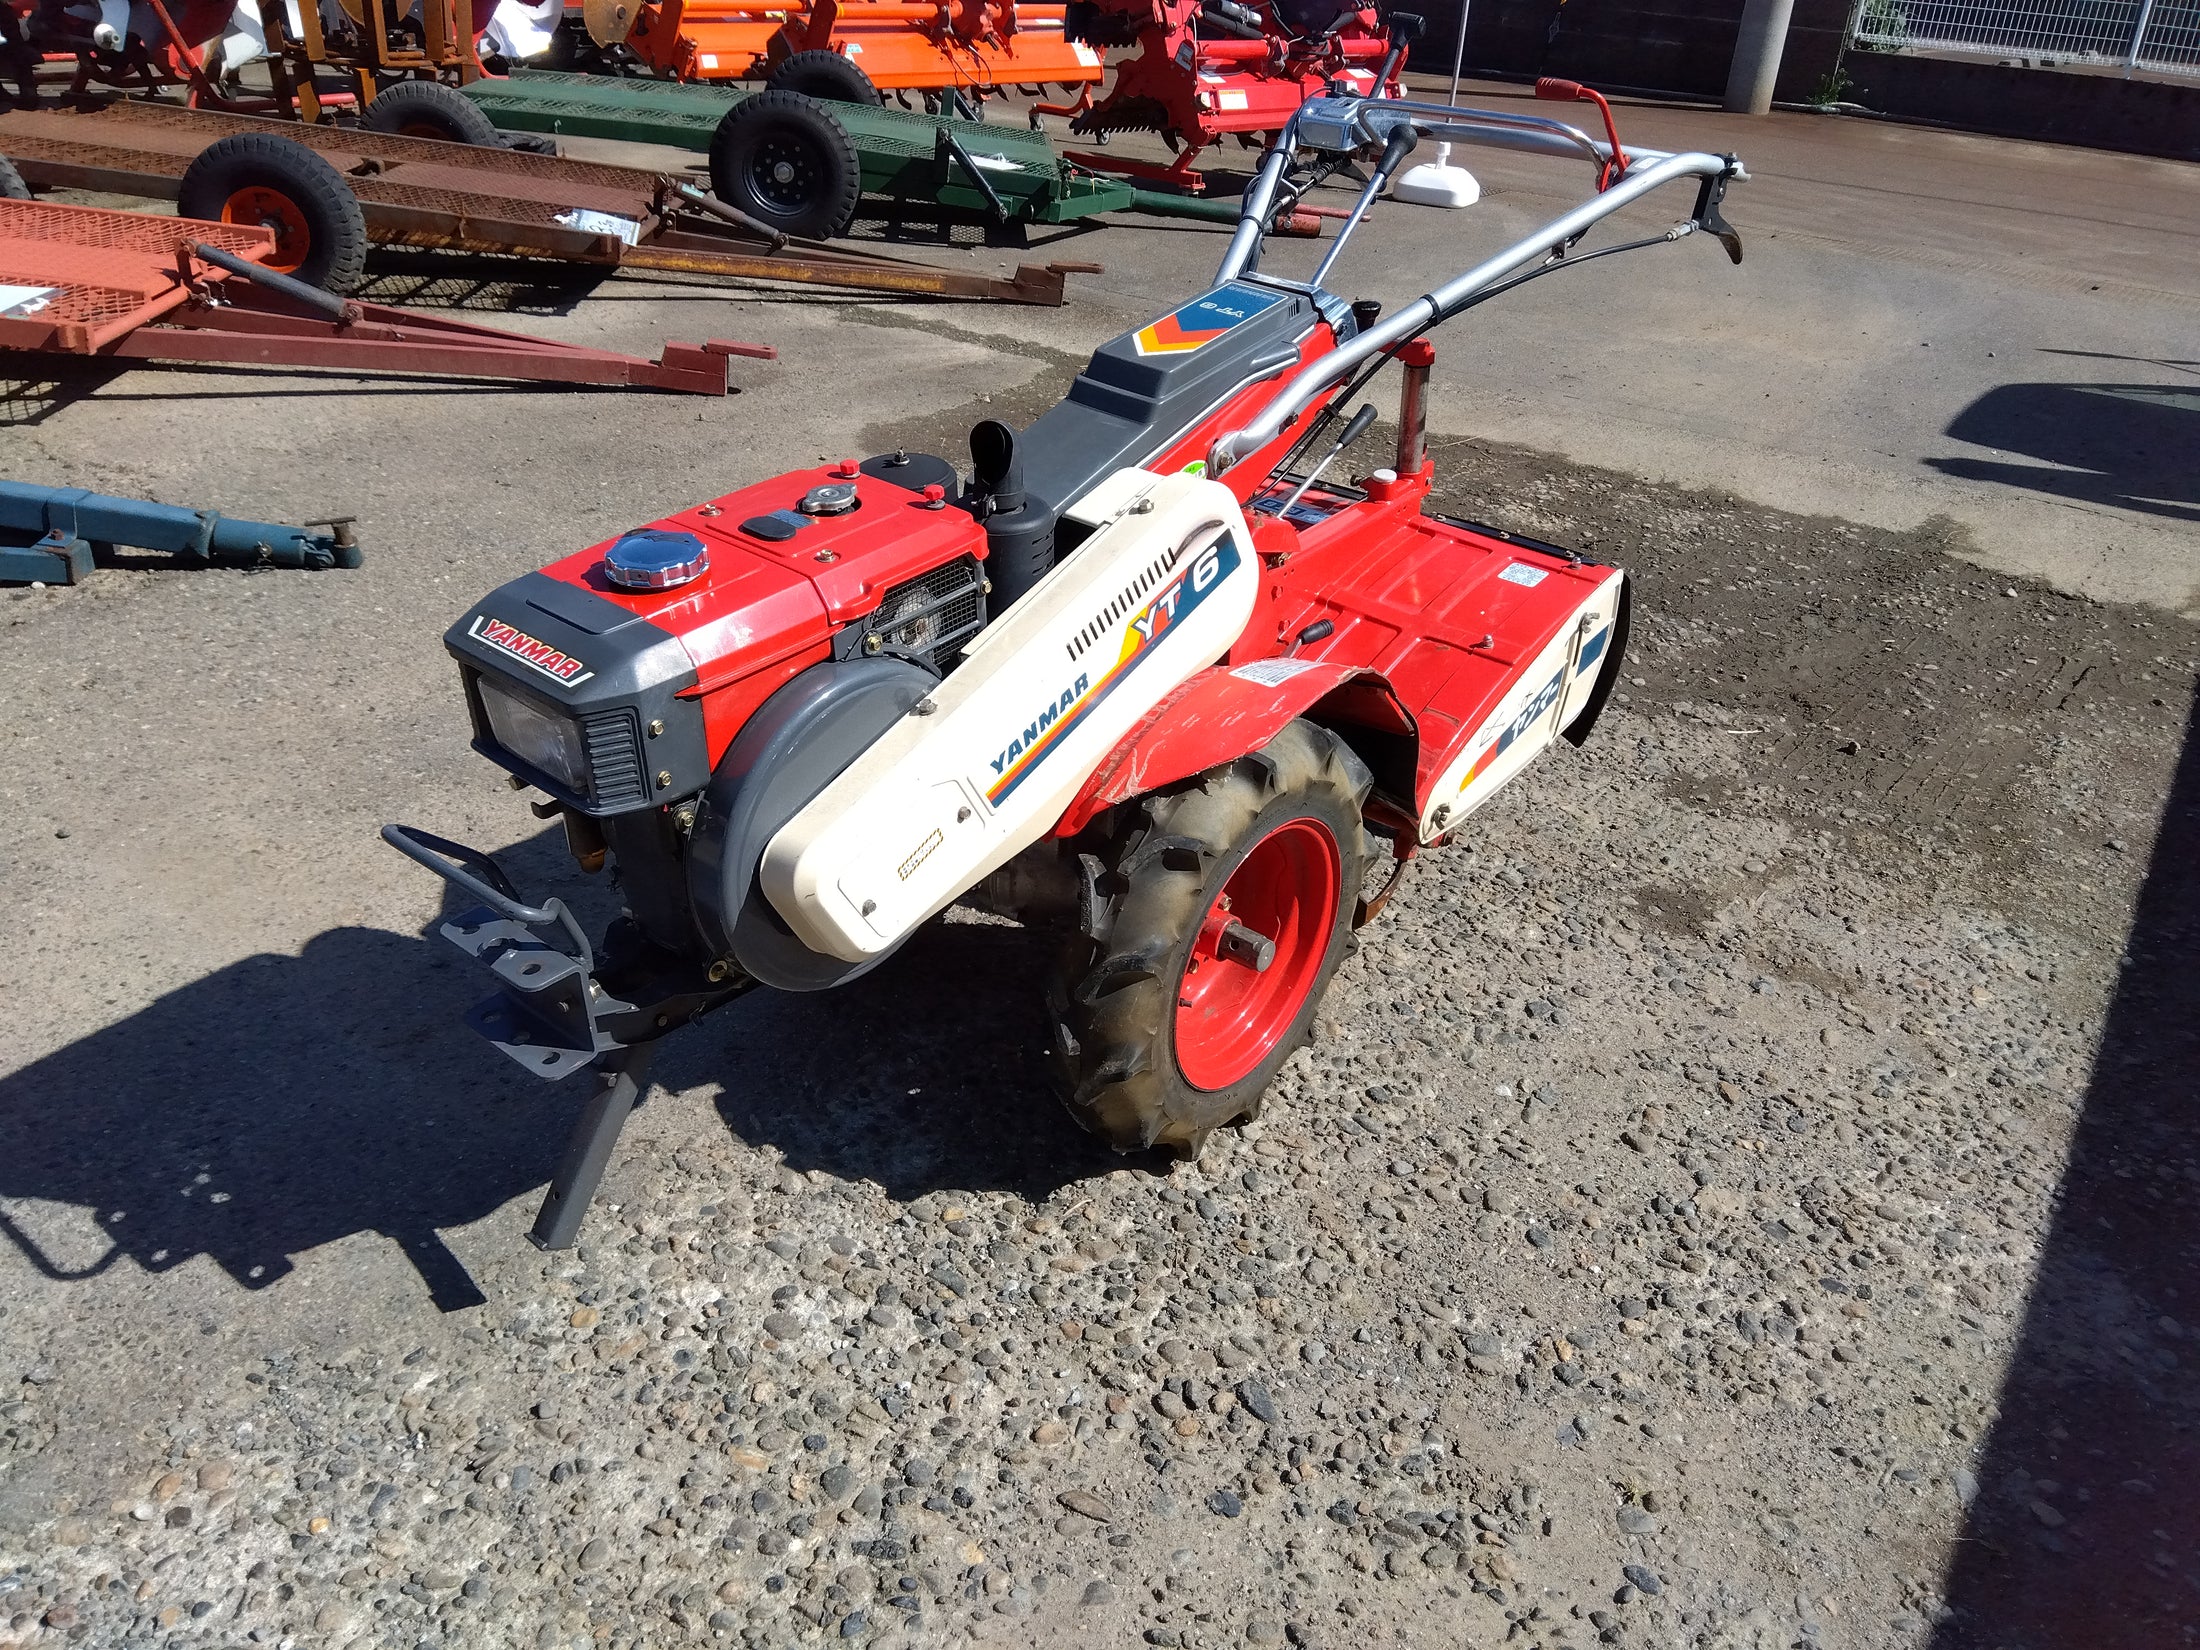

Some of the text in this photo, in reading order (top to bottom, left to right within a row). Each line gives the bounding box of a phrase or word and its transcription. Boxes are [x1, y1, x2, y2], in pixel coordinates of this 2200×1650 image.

[1131, 545, 1220, 642] YT 6
[481, 619, 583, 678] YANMAR
[990, 672, 1089, 774] YANMAR
